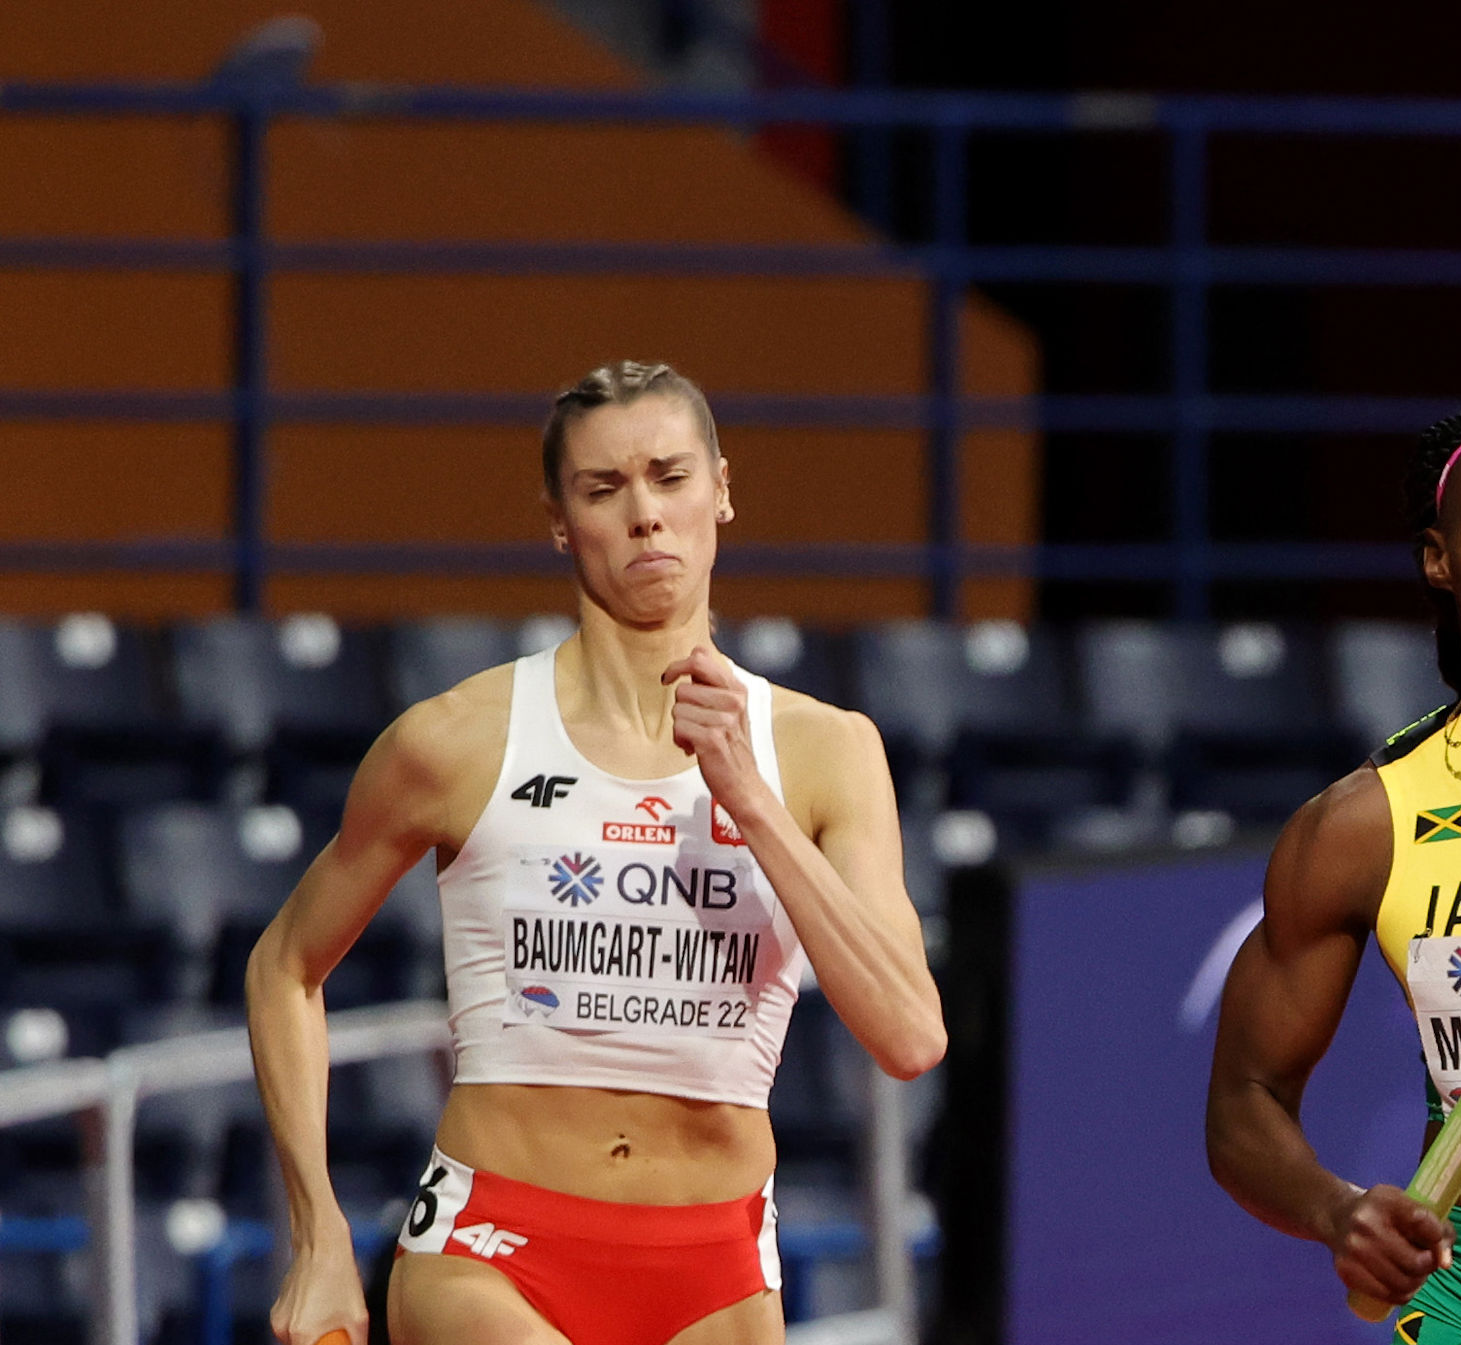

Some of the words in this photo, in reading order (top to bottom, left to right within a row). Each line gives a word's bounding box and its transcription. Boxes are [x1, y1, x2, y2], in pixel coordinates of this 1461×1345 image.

[511, 773, 579, 809] 4F
[605, 824, 673, 843] ORLEN
[616, 862, 738, 911] QNB
[512, 916, 760, 986] BAUMGART-WITAN
[576, 991, 710, 1029] BELGRADE
[716, 1000, 748, 1029] 22
[408, 1165, 449, 1238] 6
[451, 1221, 529, 1259] 4F
